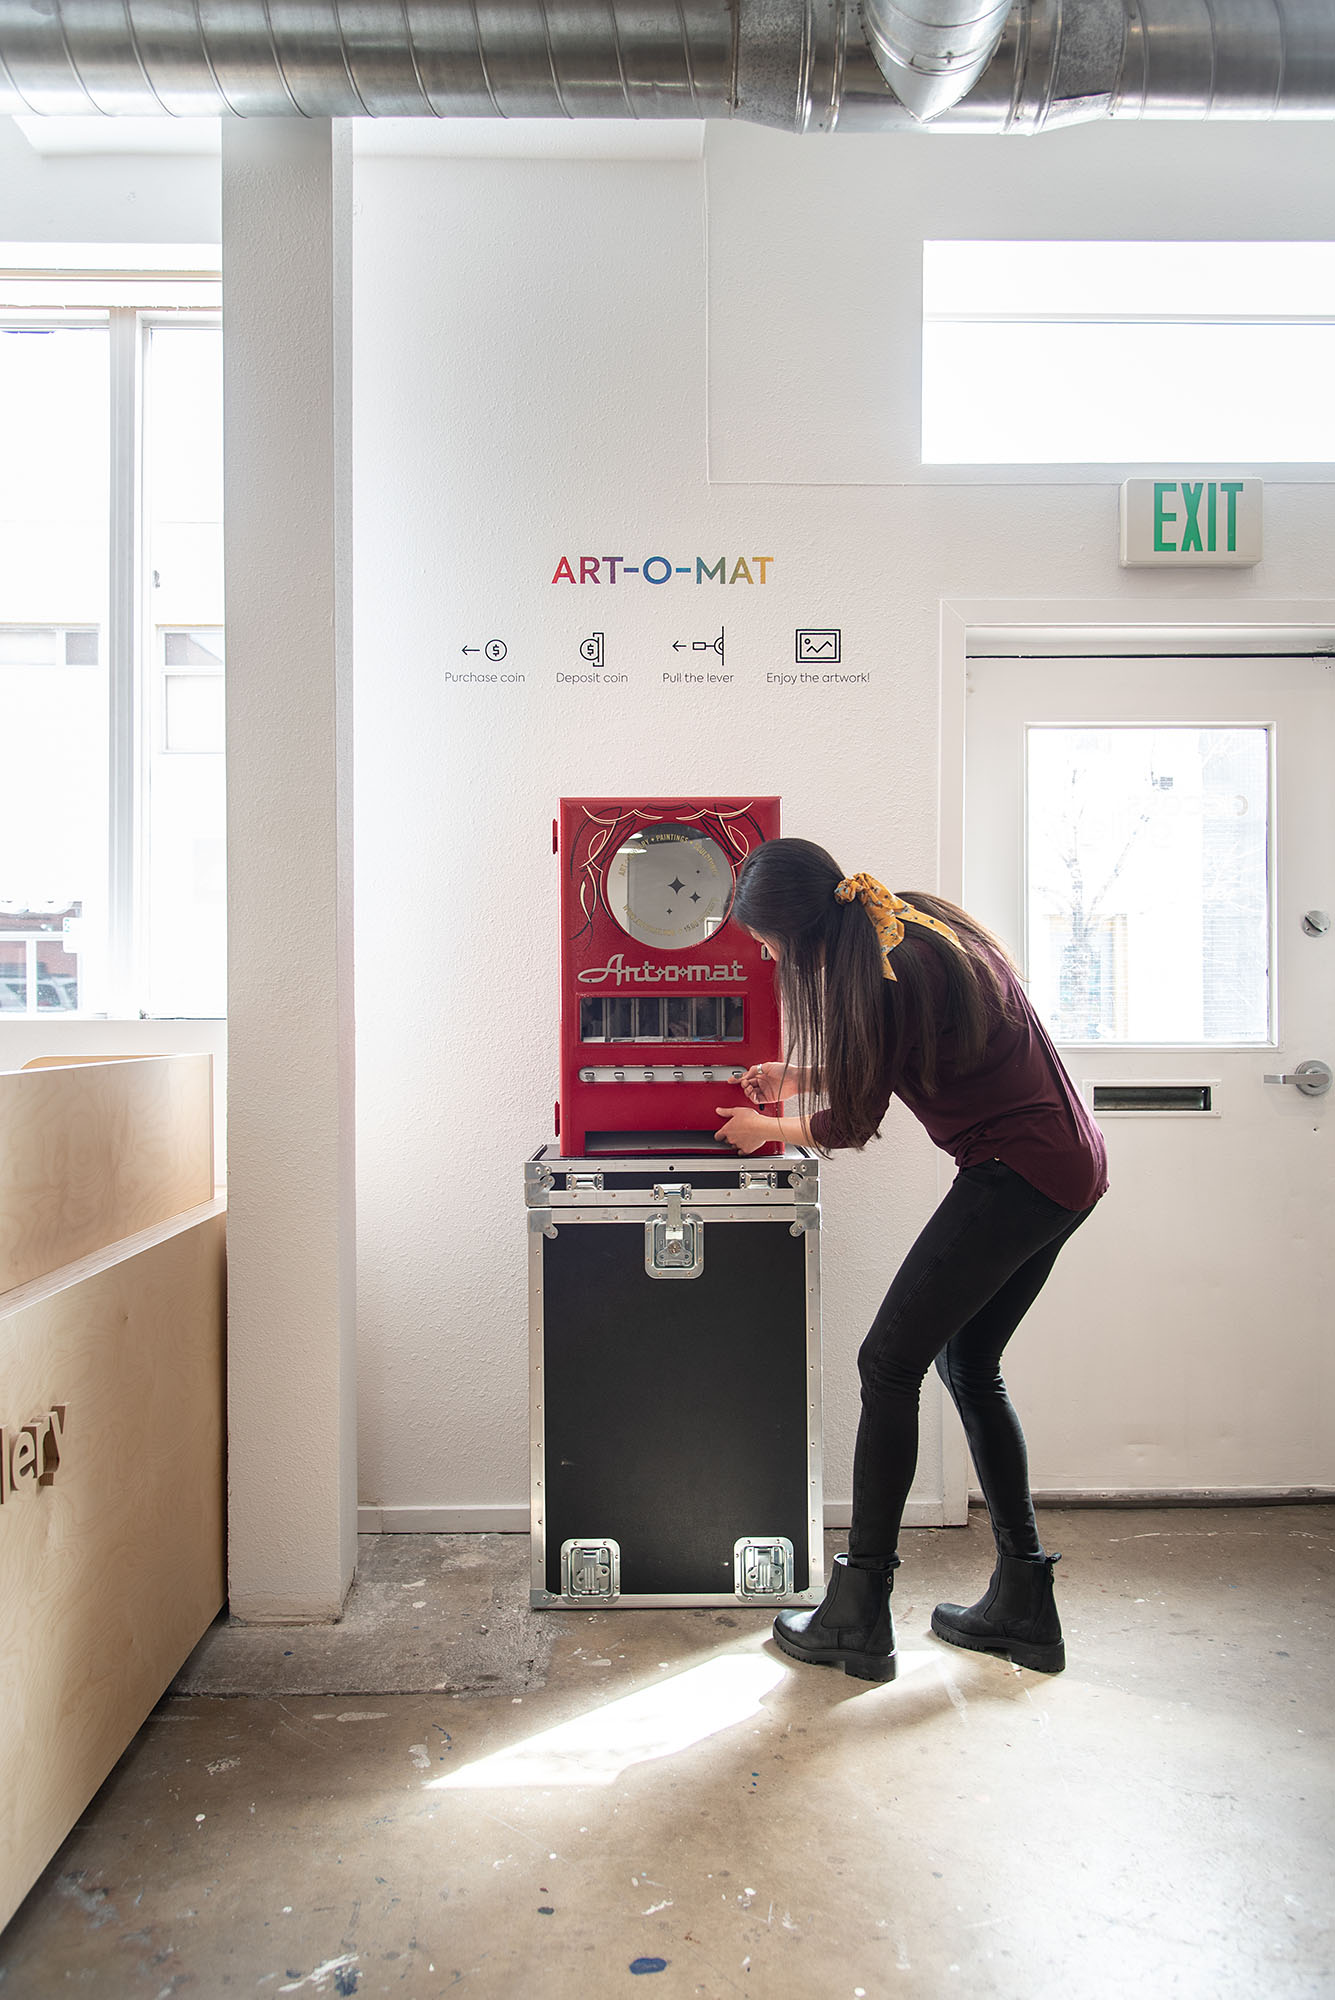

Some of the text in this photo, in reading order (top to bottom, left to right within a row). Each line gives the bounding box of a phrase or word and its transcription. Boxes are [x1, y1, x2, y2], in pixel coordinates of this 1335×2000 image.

[1154, 482, 1244, 552] EXIT
[551, 556, 774, 585] ART-O-MAT
[444, 671, 526, 683] Purchase coin
[556, 672, 629, 686] Deposit coin
[662, 671, 734, 684] Pull the lever
[765, 671, 871, 687] Enjoy the artwork!
[655, 833, 690, 844] PAINTINGS
